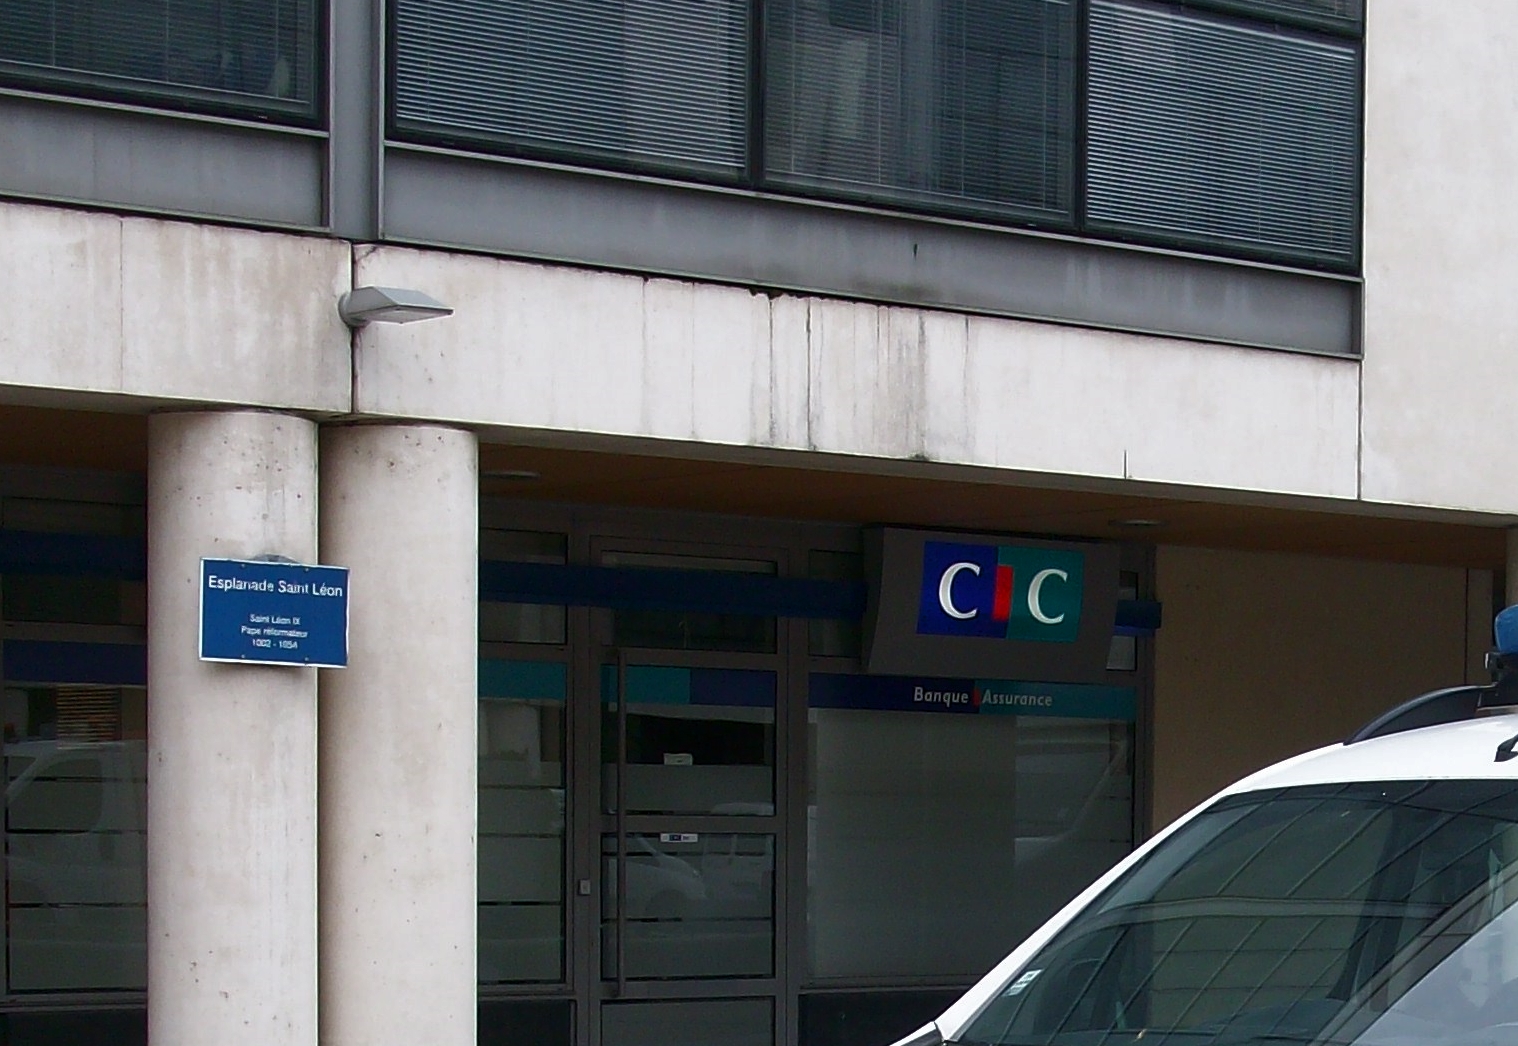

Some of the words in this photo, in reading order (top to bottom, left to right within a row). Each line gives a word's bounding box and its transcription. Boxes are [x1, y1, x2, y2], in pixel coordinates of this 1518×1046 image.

[208, 575, 274, 592] Esplanade
[278, 580, 309, 594] Saint
[312, 581, 343, 597] Léon
[938, 562, 1069, 624] CIC
[250, 614, 270, 624] Saint
[271, 615, 291, 625] Léon
[293, 617, 301, 625] IX
[241, 626, 261, 636] Pape
[914, 686, 969, 708] Banque
[982, 689, 1053, 707] Assurance
